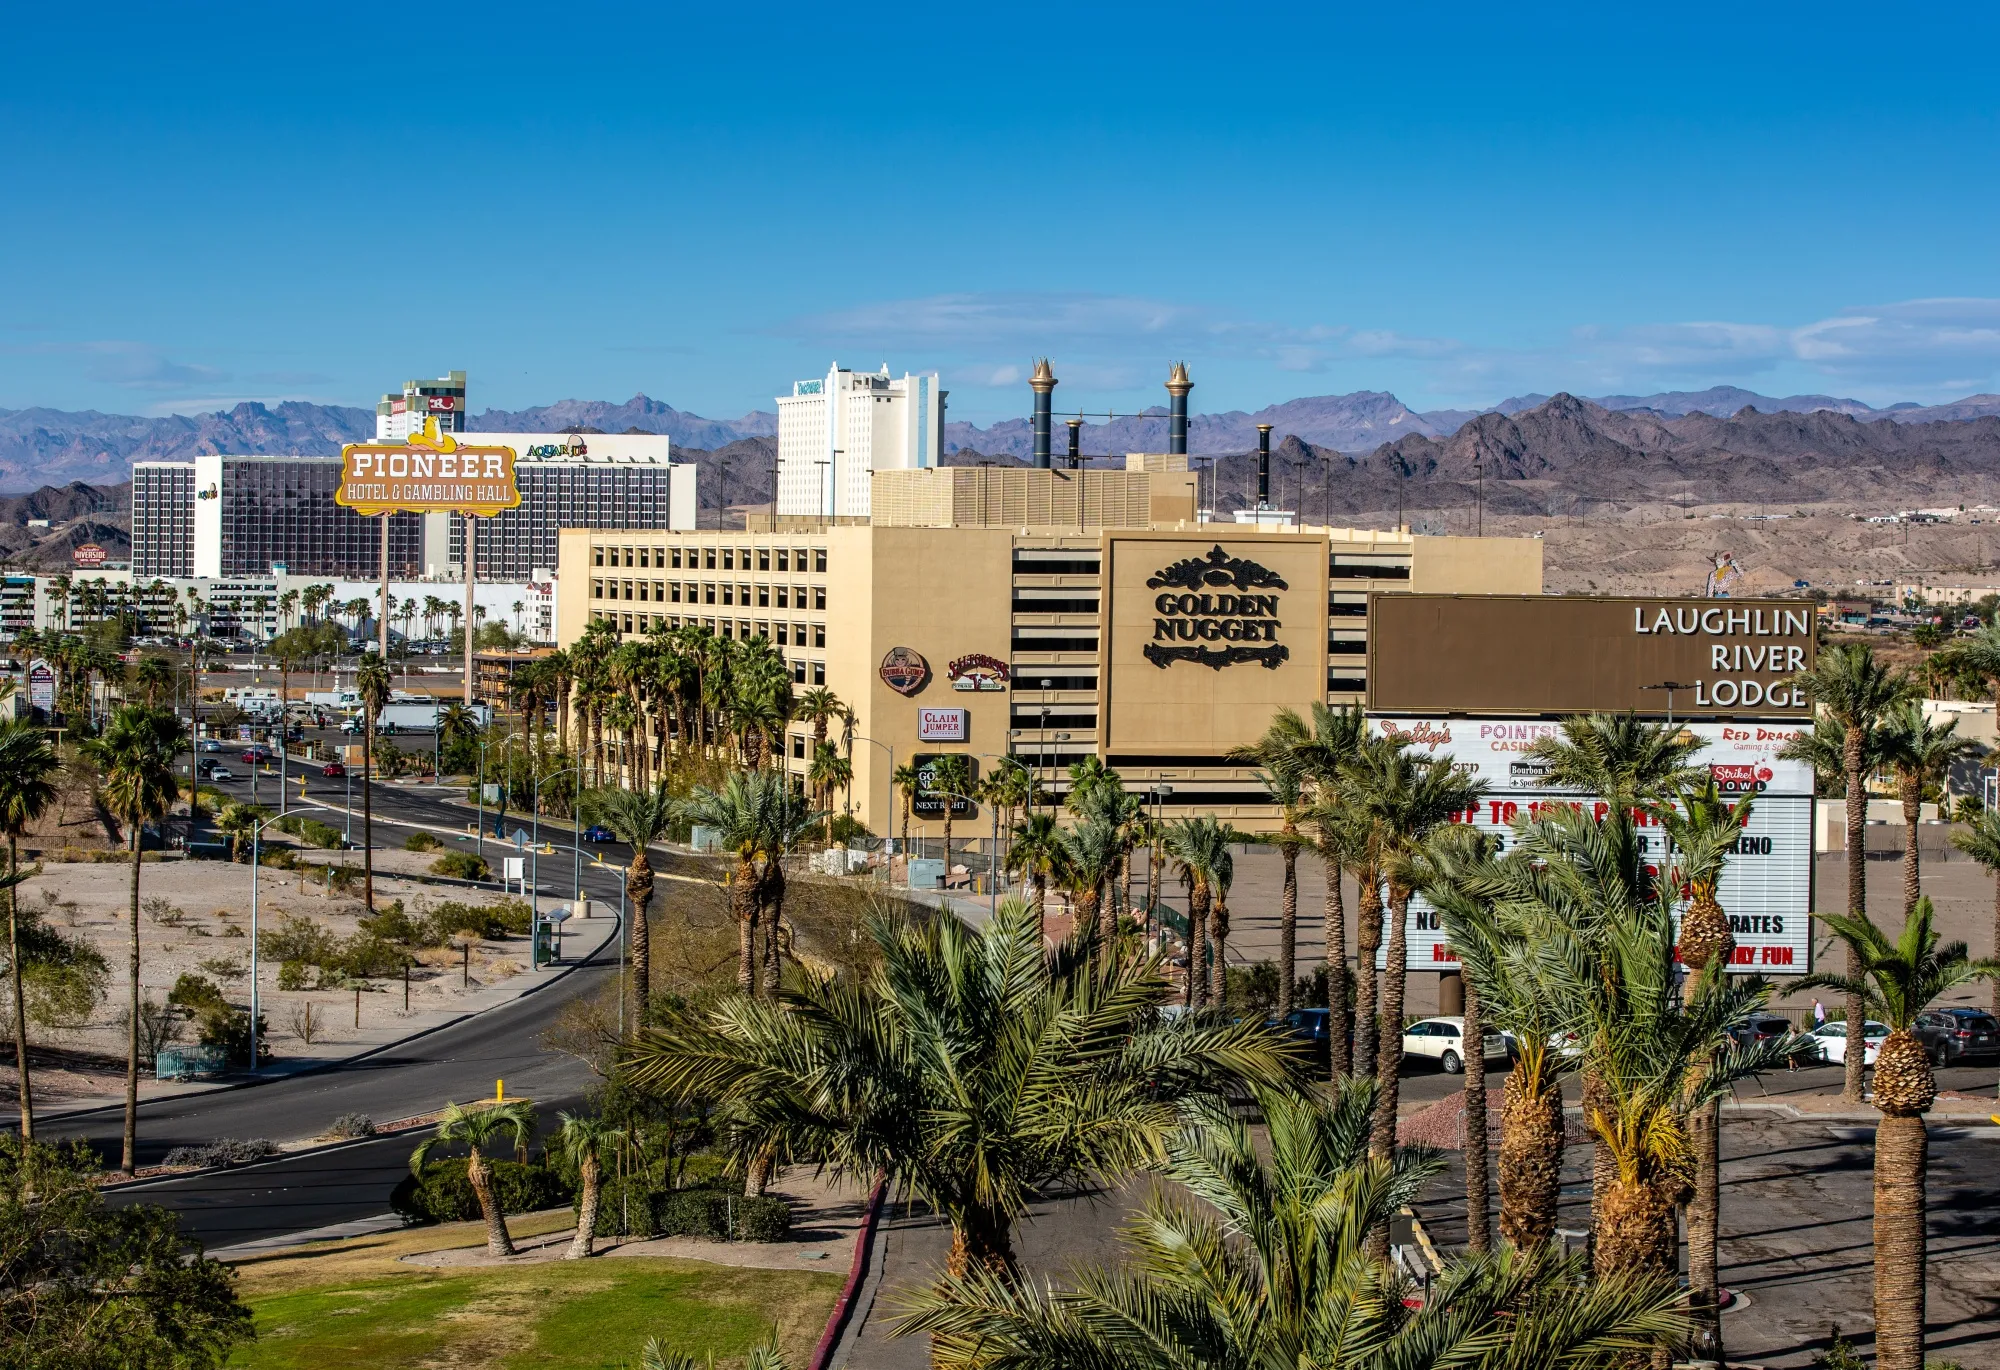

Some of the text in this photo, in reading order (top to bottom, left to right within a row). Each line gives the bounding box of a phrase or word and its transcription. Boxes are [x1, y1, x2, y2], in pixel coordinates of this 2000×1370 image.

[352, 453, 505, 478] PIONEER
[347, 483, 511, 501] HOTEL & GAMBLING HALL
[75, 551, 106, 559] RIVERSIDE
[1155, 593, 1281, 618] GOLDEN
[1152, 618, 1282, 642] NUGGET
[1634, 607, 1808, 636] LAUGHLIN
[1711, 644, 1807, 672] RIVER
[882, 668, 904, 676] BUBBA
[905, 667, 924, 677] GUMP
[1695, 679, 1807, 708] LODGE
[924, 712, 958, 723] CLAIM
[922, 723, 960, 734] JUMPER
[1380, 720, 1452, 752] Dotty's
[1480, 724, 1558, 740] POINTS!
[1722, 727, 1803, 741] RED DRAGO
[1490, 741, 1536, 752] CASIN
[1733, 743, 1762, 752] Gaming
[1764, 743, 1770, 751] &
[1511, 765, 1543, 775] Bourbon
[1714, 766, 1753, 781] Strike!
[916, 801, 966, 810] NEXT RHT
[1489, 801, 1518, 826] TO
[1728, 836, 1773, 855] KENO
[1729, 914, 1784, 934] RATES
[1762, 946, 1793, 965] FUN
